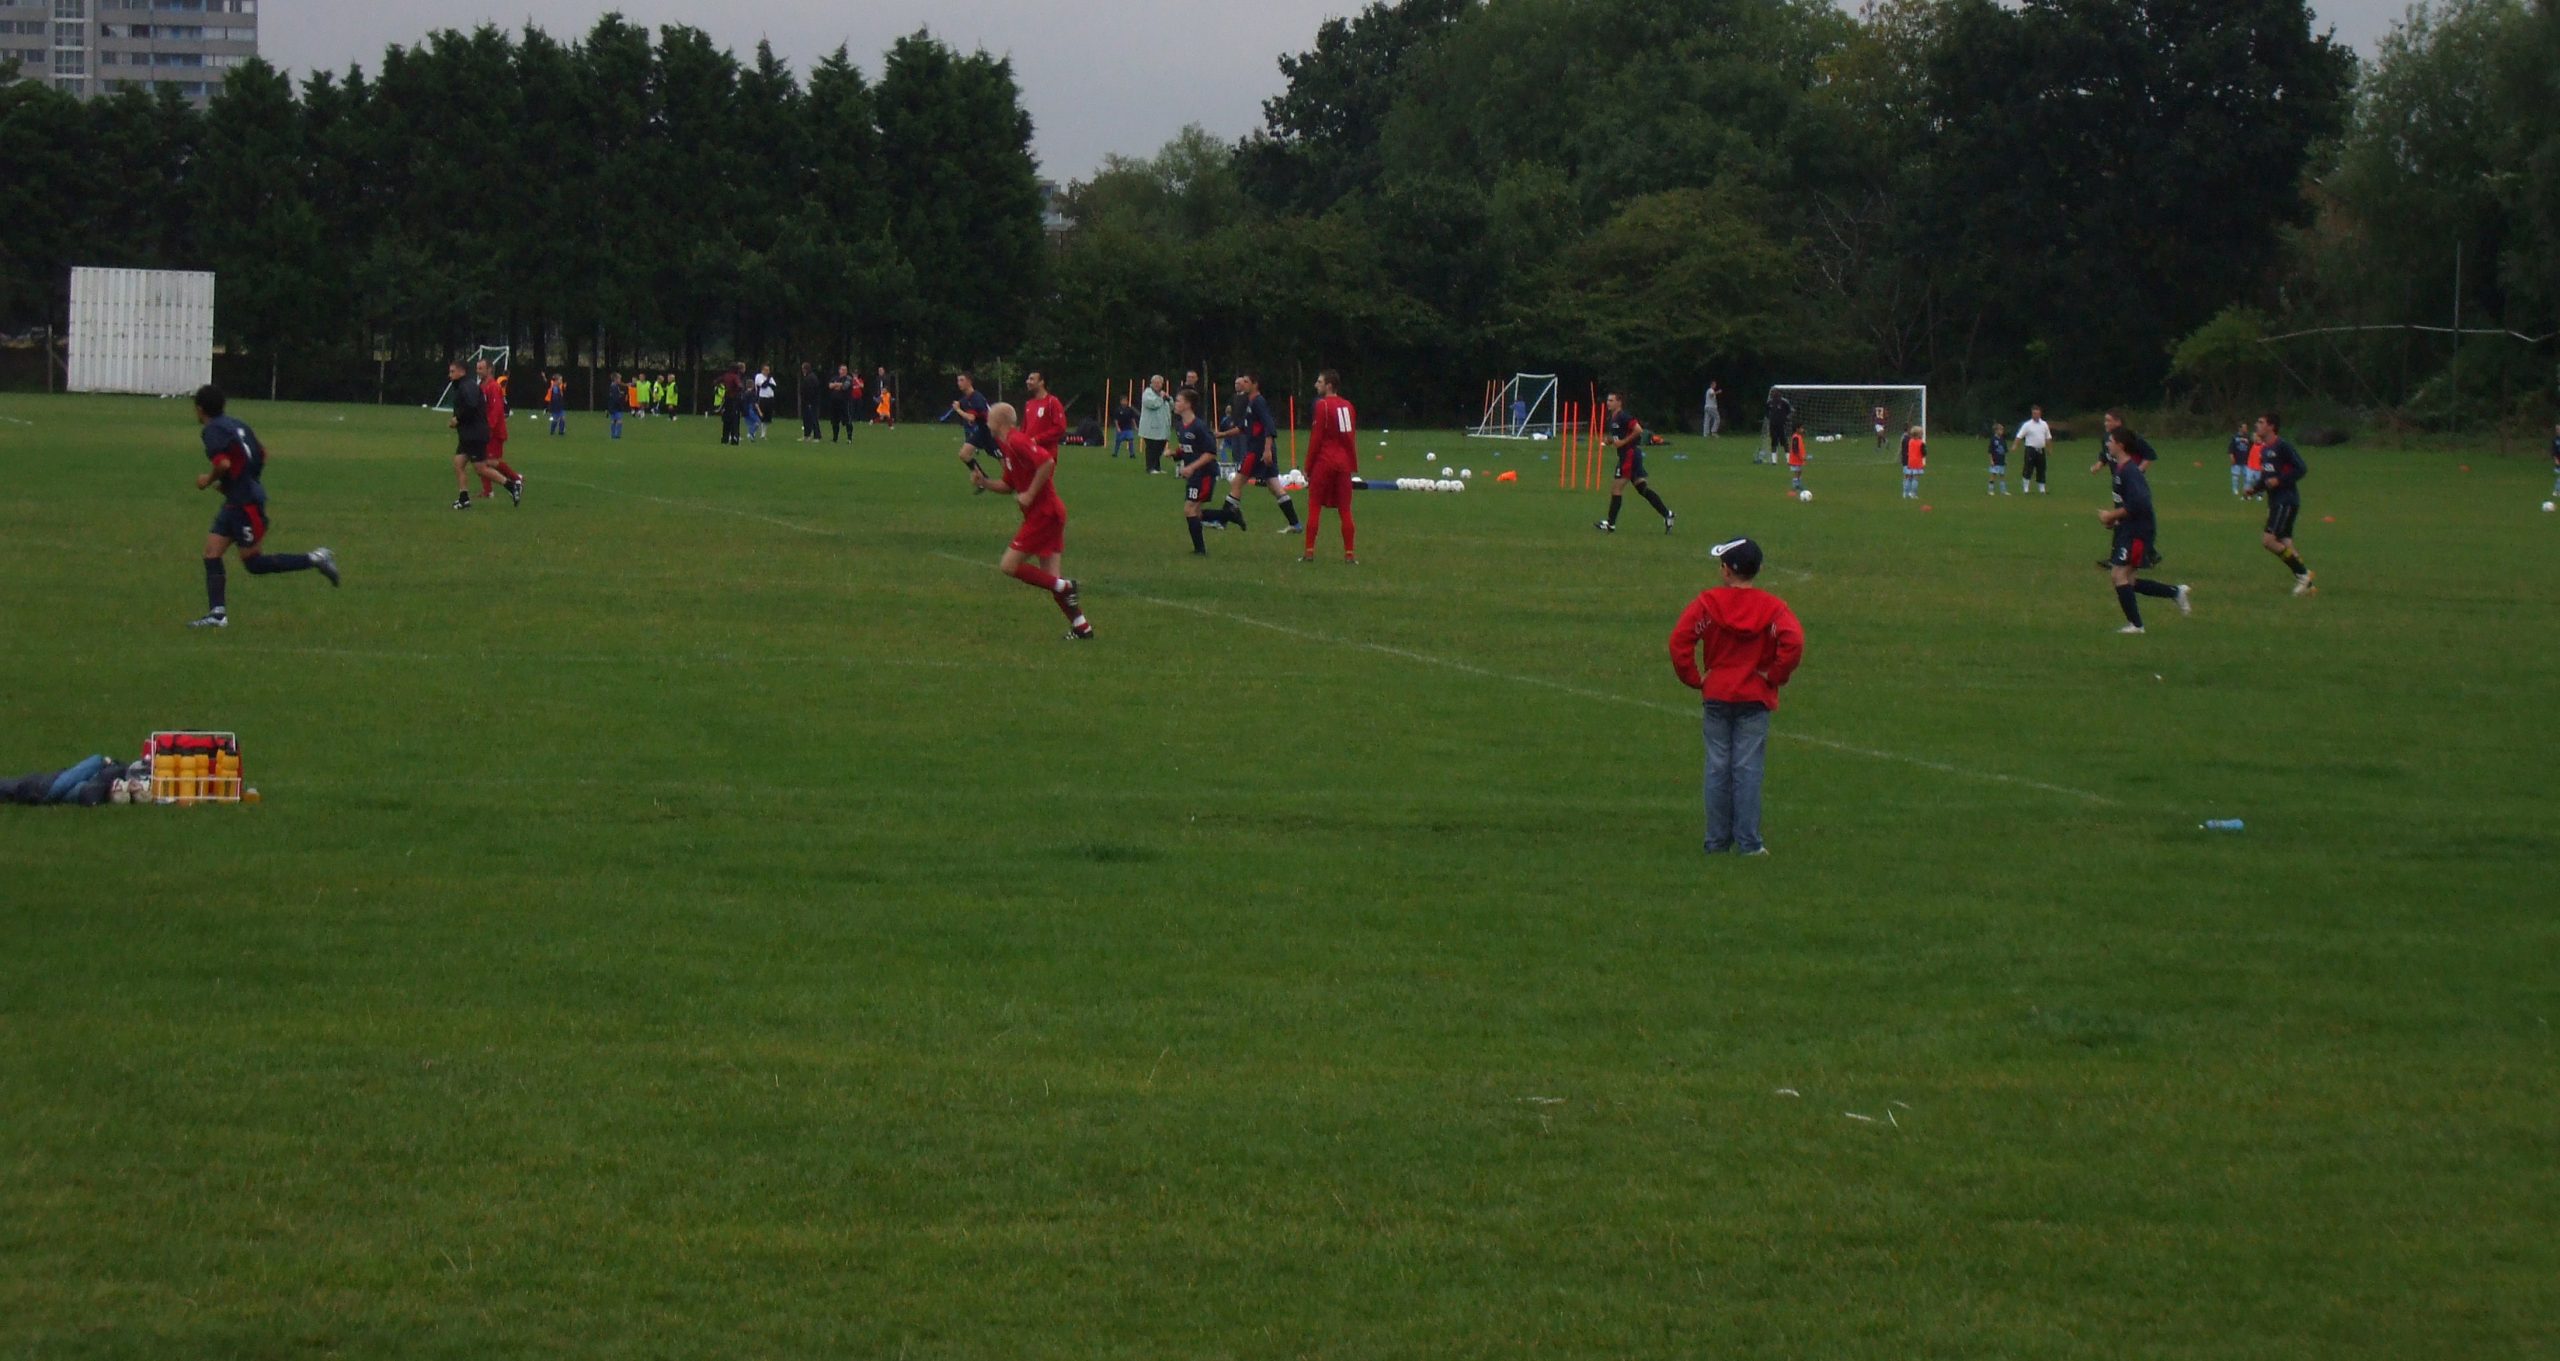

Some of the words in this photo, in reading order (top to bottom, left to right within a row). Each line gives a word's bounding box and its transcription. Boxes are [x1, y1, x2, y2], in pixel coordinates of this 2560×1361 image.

[1337, 406, 1352, 432] 11
[1188, 487, 1199, 500] 18
[242, 526, 254, 542] 5
[2119, 547, 2128, 561] 3
